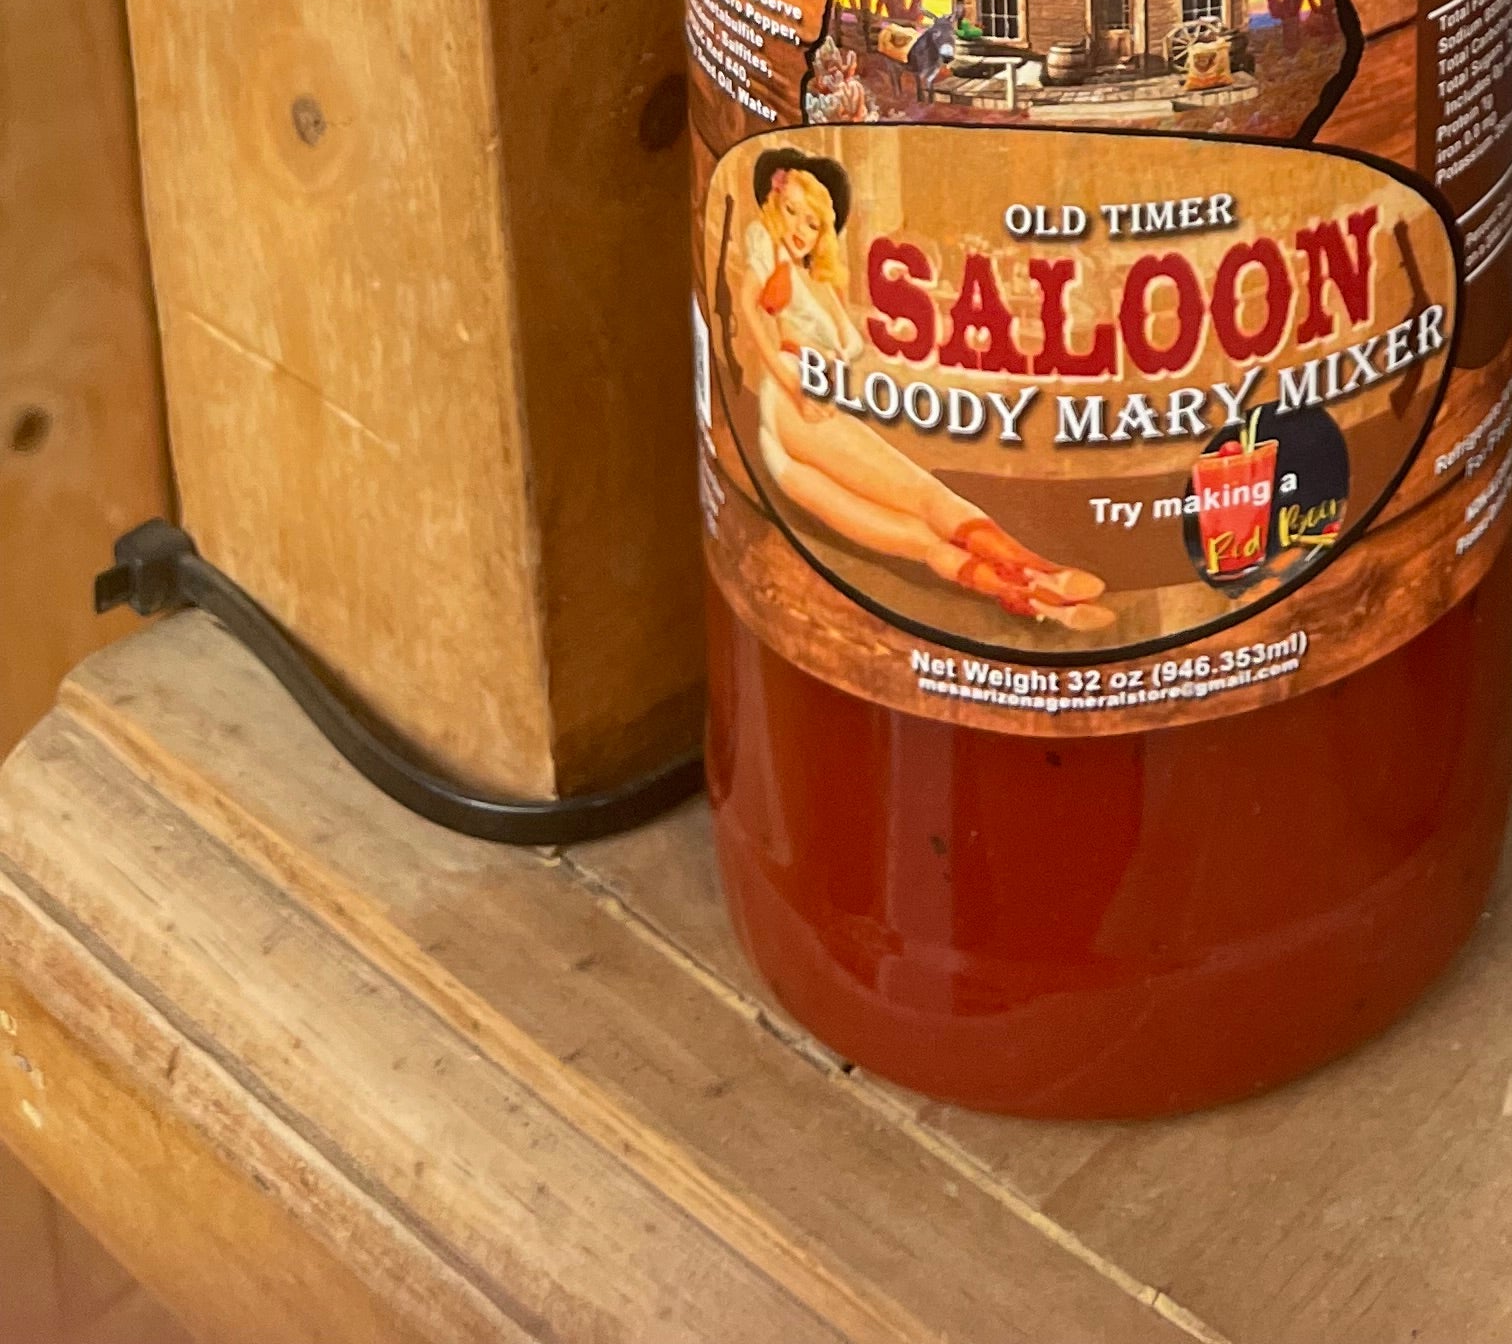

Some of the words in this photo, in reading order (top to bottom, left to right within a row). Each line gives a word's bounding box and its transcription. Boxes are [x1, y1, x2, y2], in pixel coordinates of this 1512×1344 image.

[745, 2, 800, 46] Pepper,
[1439, 1, 1470, 32] Total
[1437, 45, 1469, 75] Total
[1437, 67, 1469, 97] Total
[737, 86, 778, 123] Water
[1005, 204, 1087, 235] OLD
[1102, 192, 1234, 235] TIMER
[867, 205, 1380, 378] SALOON
[800, 346, 1039, 442] BLOODY
[1053, 365, 1264, 442] MARY
[1276, 305, 1444, 415] MIXER
[1089, 497, 1143, 528] Try
[1152, 478, 1271, 520] making
[1279, 472, 1298, 493] a
[911, 649, 957, 679] Net
[962, 660, 1059, 694] Weight
[1067, 670, 1101, 695] 32
[1109, 668, 1144, 689] oz
[1151, 629, 1308, 688] (946.353ml)
